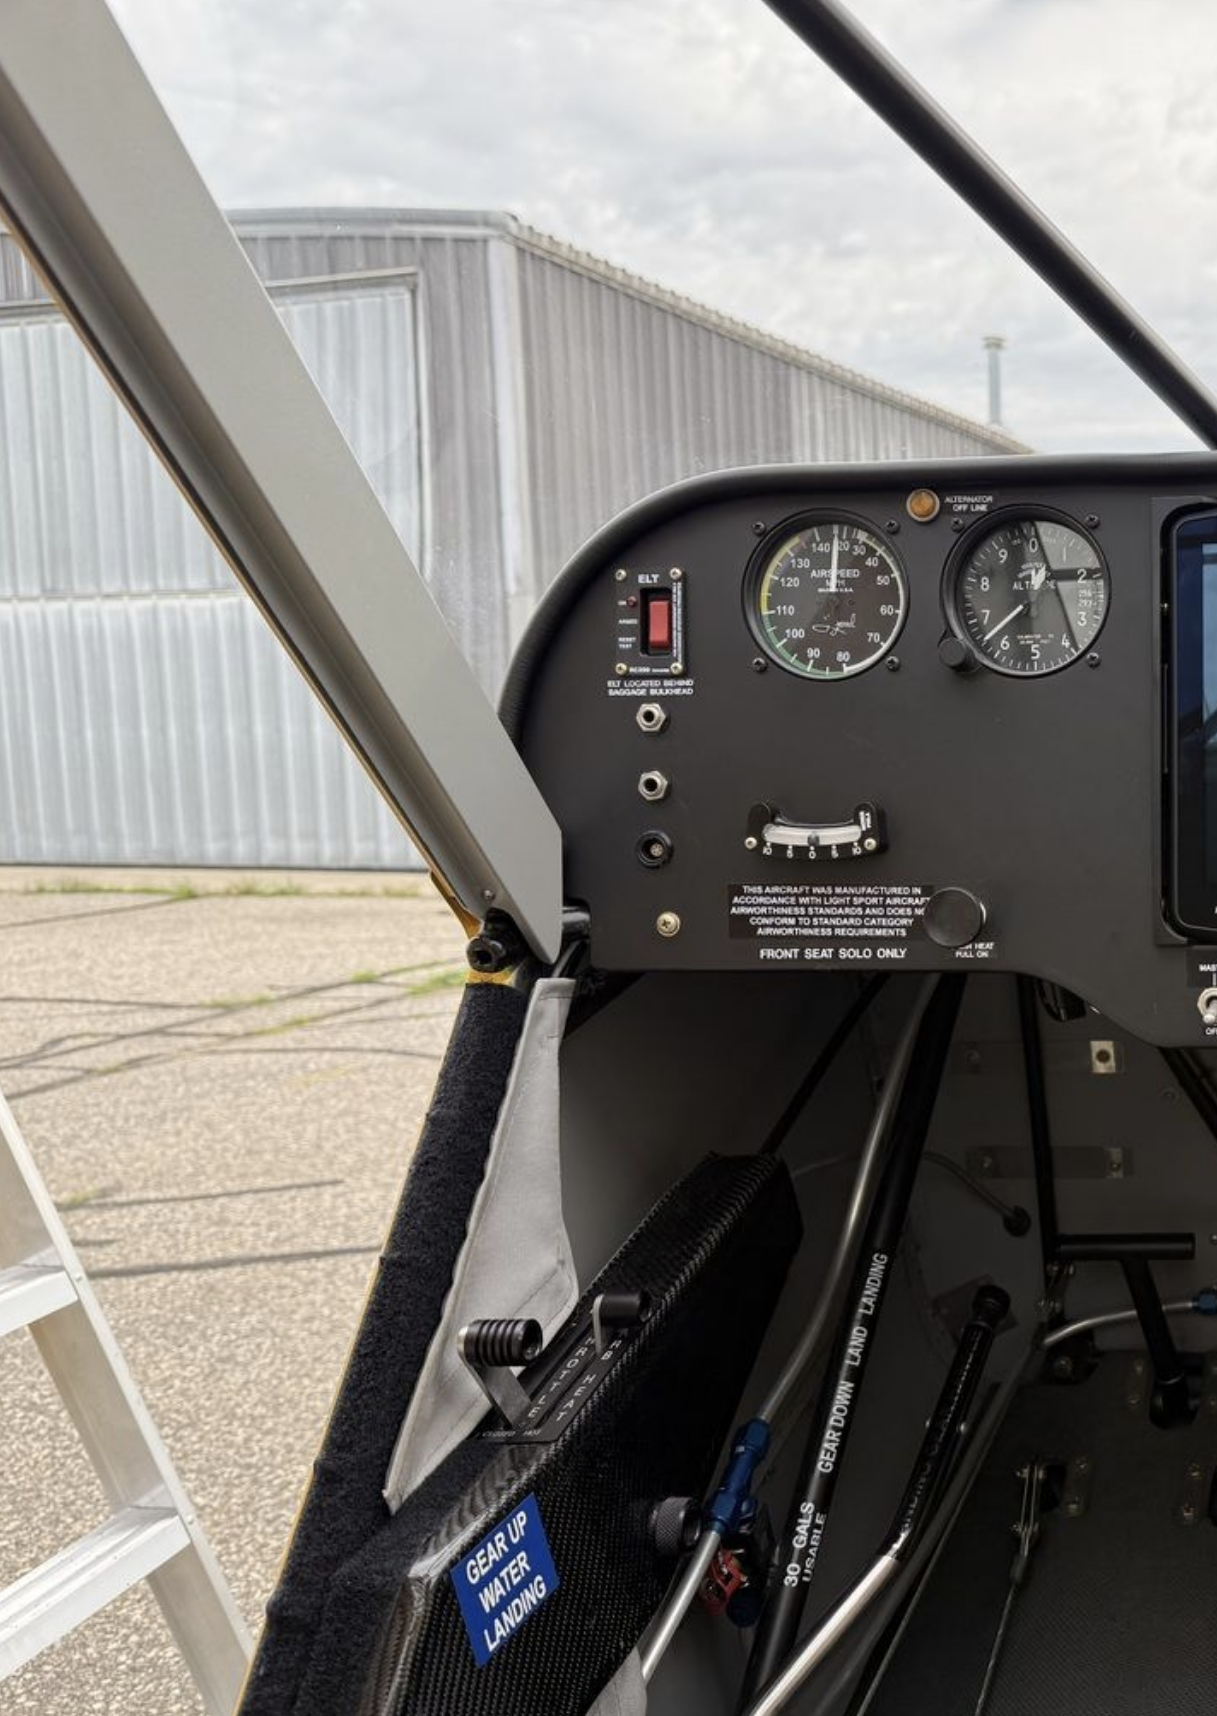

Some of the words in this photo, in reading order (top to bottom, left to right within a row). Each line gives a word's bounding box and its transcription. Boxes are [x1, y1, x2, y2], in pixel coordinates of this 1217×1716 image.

[944, 495, 993, 503] ALTERNATOR
[953, 503, 968, 511] OFF
[970, 503, 988, 512] LINE
[812, 543, 830, 553] 140
[852, 545, 866, 556] 30
[1029, 538, 1039, 553] 0
[998, 549, 1008, 563] 9
[790, 558, 810, 568] 130
[865, 557, 878, 567] 40
[637, 573, 660, 584] ELT
[810, 568, 860, 579] AIRSPEED
[1077, 568, 1088, 584] 2
[780, 577, 800, 588] 120
[876, 575, 891, 586] 50
[980, 576, 990, 591] 8
[776, 605, 795, 616] 110
[879, 605, 894, 616] 60
[981, 609, 991, 625] 7
[1077, 611, 1087, 626] 3
[785, 628, 805, 639] 100
[866, 632, 881, 644] 70
[1000, 635, 1010, 650] 6
[806, 647, 821, 659] 90
[836, 651, 850, 662] 80
[1030, 644, 1041, 660] 5
[607, 680, 622, 688] ELT
[624, 680, 661, 688] LOCATED
[663, 679, 694, 687] BEHIND
[608, 688, 647, 696] BAGGAGE
[649, 688, 694, 696] BULKHEAD
[742, 886, 763, 895] THIS
[764, 886, 811, 895] AIRCRAFT
[812, 886, 833, 895] WAS
[834, 886, 911, 895] MANUFACTURED
[911, 886, 922, 896] IN
[732, 896, 796, 906] ACCORDANCE
[798, 896, 822, 905] WITH
[824, 896, 850, 906] LIGHT
[852, 896, 884, 905] SPORT
[885, 896, 931, 905] AIRCRAFT
[730, 906, 806, 916] AIRWORTHINESS
[807, 906, 863, 916] STANDARDS
[864, 906, 884, 916] AND
[886, 906, 913, 916] DOES
[749, 916, 796, 926] CONFORM
[797, 916, 811, 926] TO
[812, 916, 863, 926] STANDARD
[864, 916, 914, 927] CATEGORY
[756, 927, 832, 937] AIRWORTHINESS
[834, 927, 907, 937] REQUIREMENTS
[974, 942, 995, 951] HEAT
[759, 948, 800, 960] FRONT
[804, 948, 834, 960] SEAT
[838, 948, 872, 959] SOLO
[877, 948, 907, 959] ONLY
[955, 951, 975, 959] PULL
[976, 951, 989, 959] ON
[858, 1252, 889, 1316] LANDING
[845, 1326, 869, 1367] LAND
[556, 1374, 597, 1422] HEAT
[828, 1380, 855, 1428] DOWN
[817, 1429, 843, 1474] GEAR
[792, 1502, 815, 1549] GALS
[465, 1531, 510, 1585] GEAR
[507, 1510, 528, 1544] UP
[802, 1512, 827, 1583] USABLE
[784, 1562, 801, 1588] 30
[478, 1551, 532, 1613] WATER
[484, 1574, 547, 1653] LANDING
